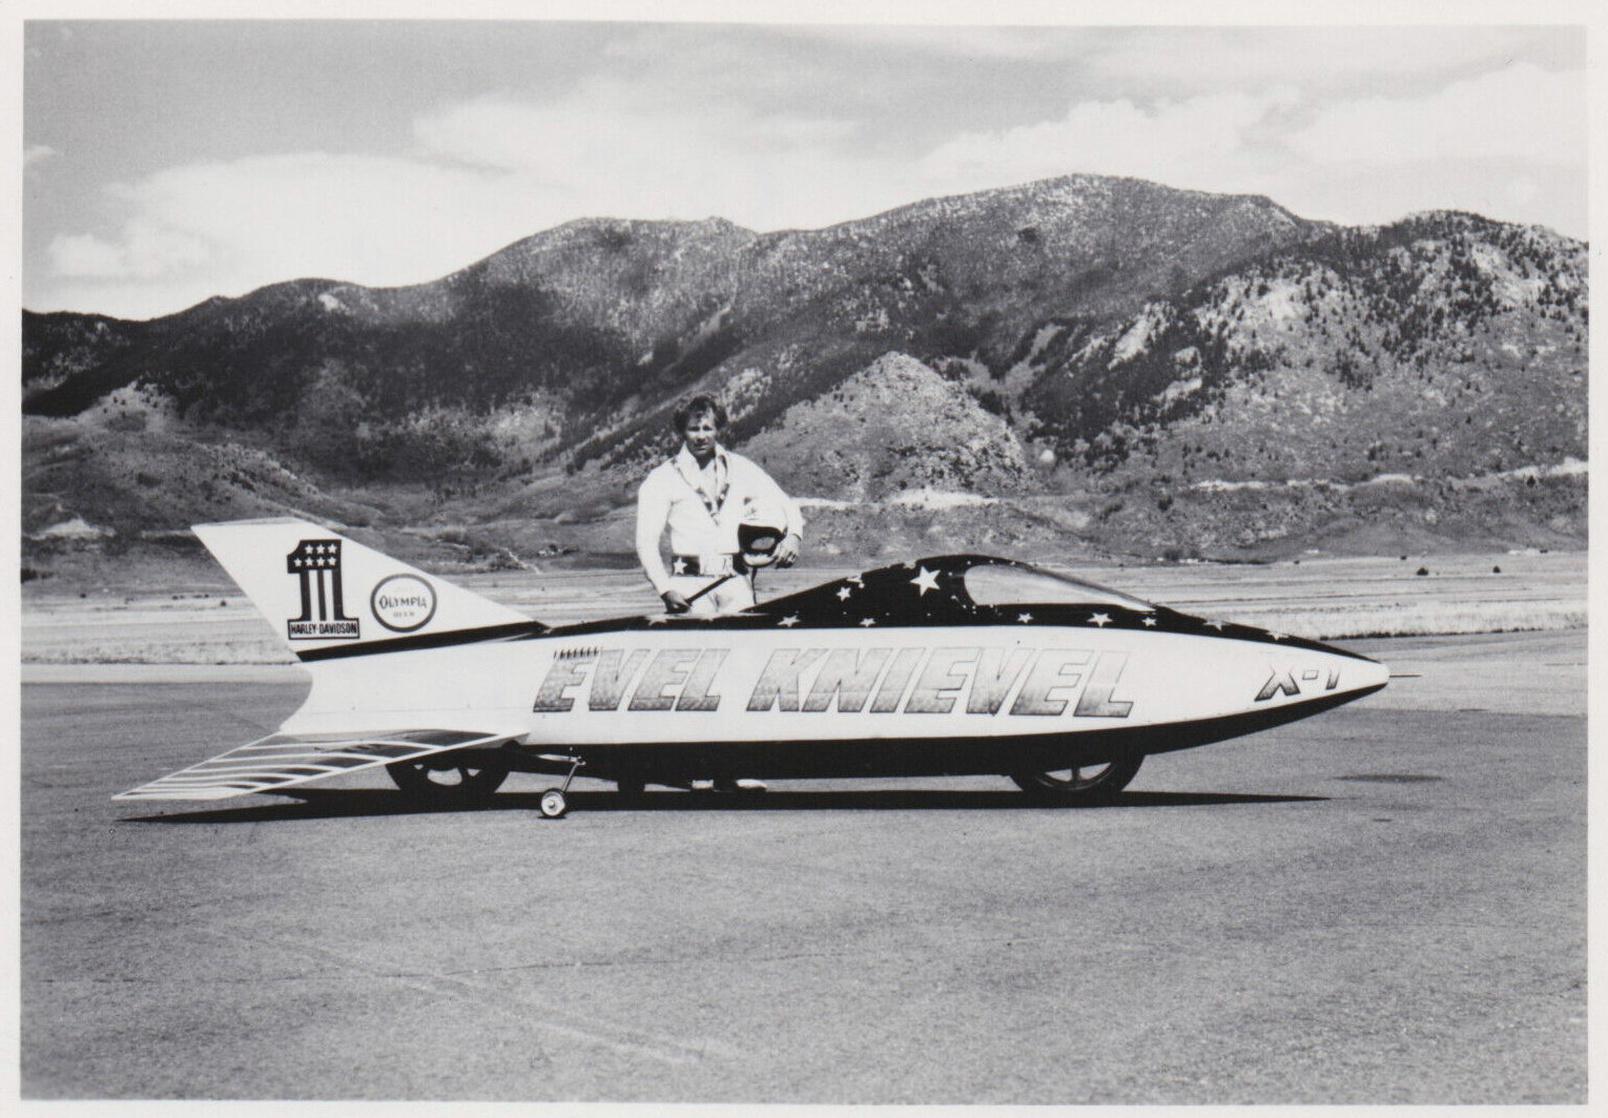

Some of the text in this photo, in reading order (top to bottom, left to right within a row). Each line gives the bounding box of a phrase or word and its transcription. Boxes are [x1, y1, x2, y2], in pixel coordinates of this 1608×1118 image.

[287, 539, 358, 622] 1
[379, 595, 427, 609] OLYMPIA
[533, 647, 1134, 717] EVEL KNIEVEL
